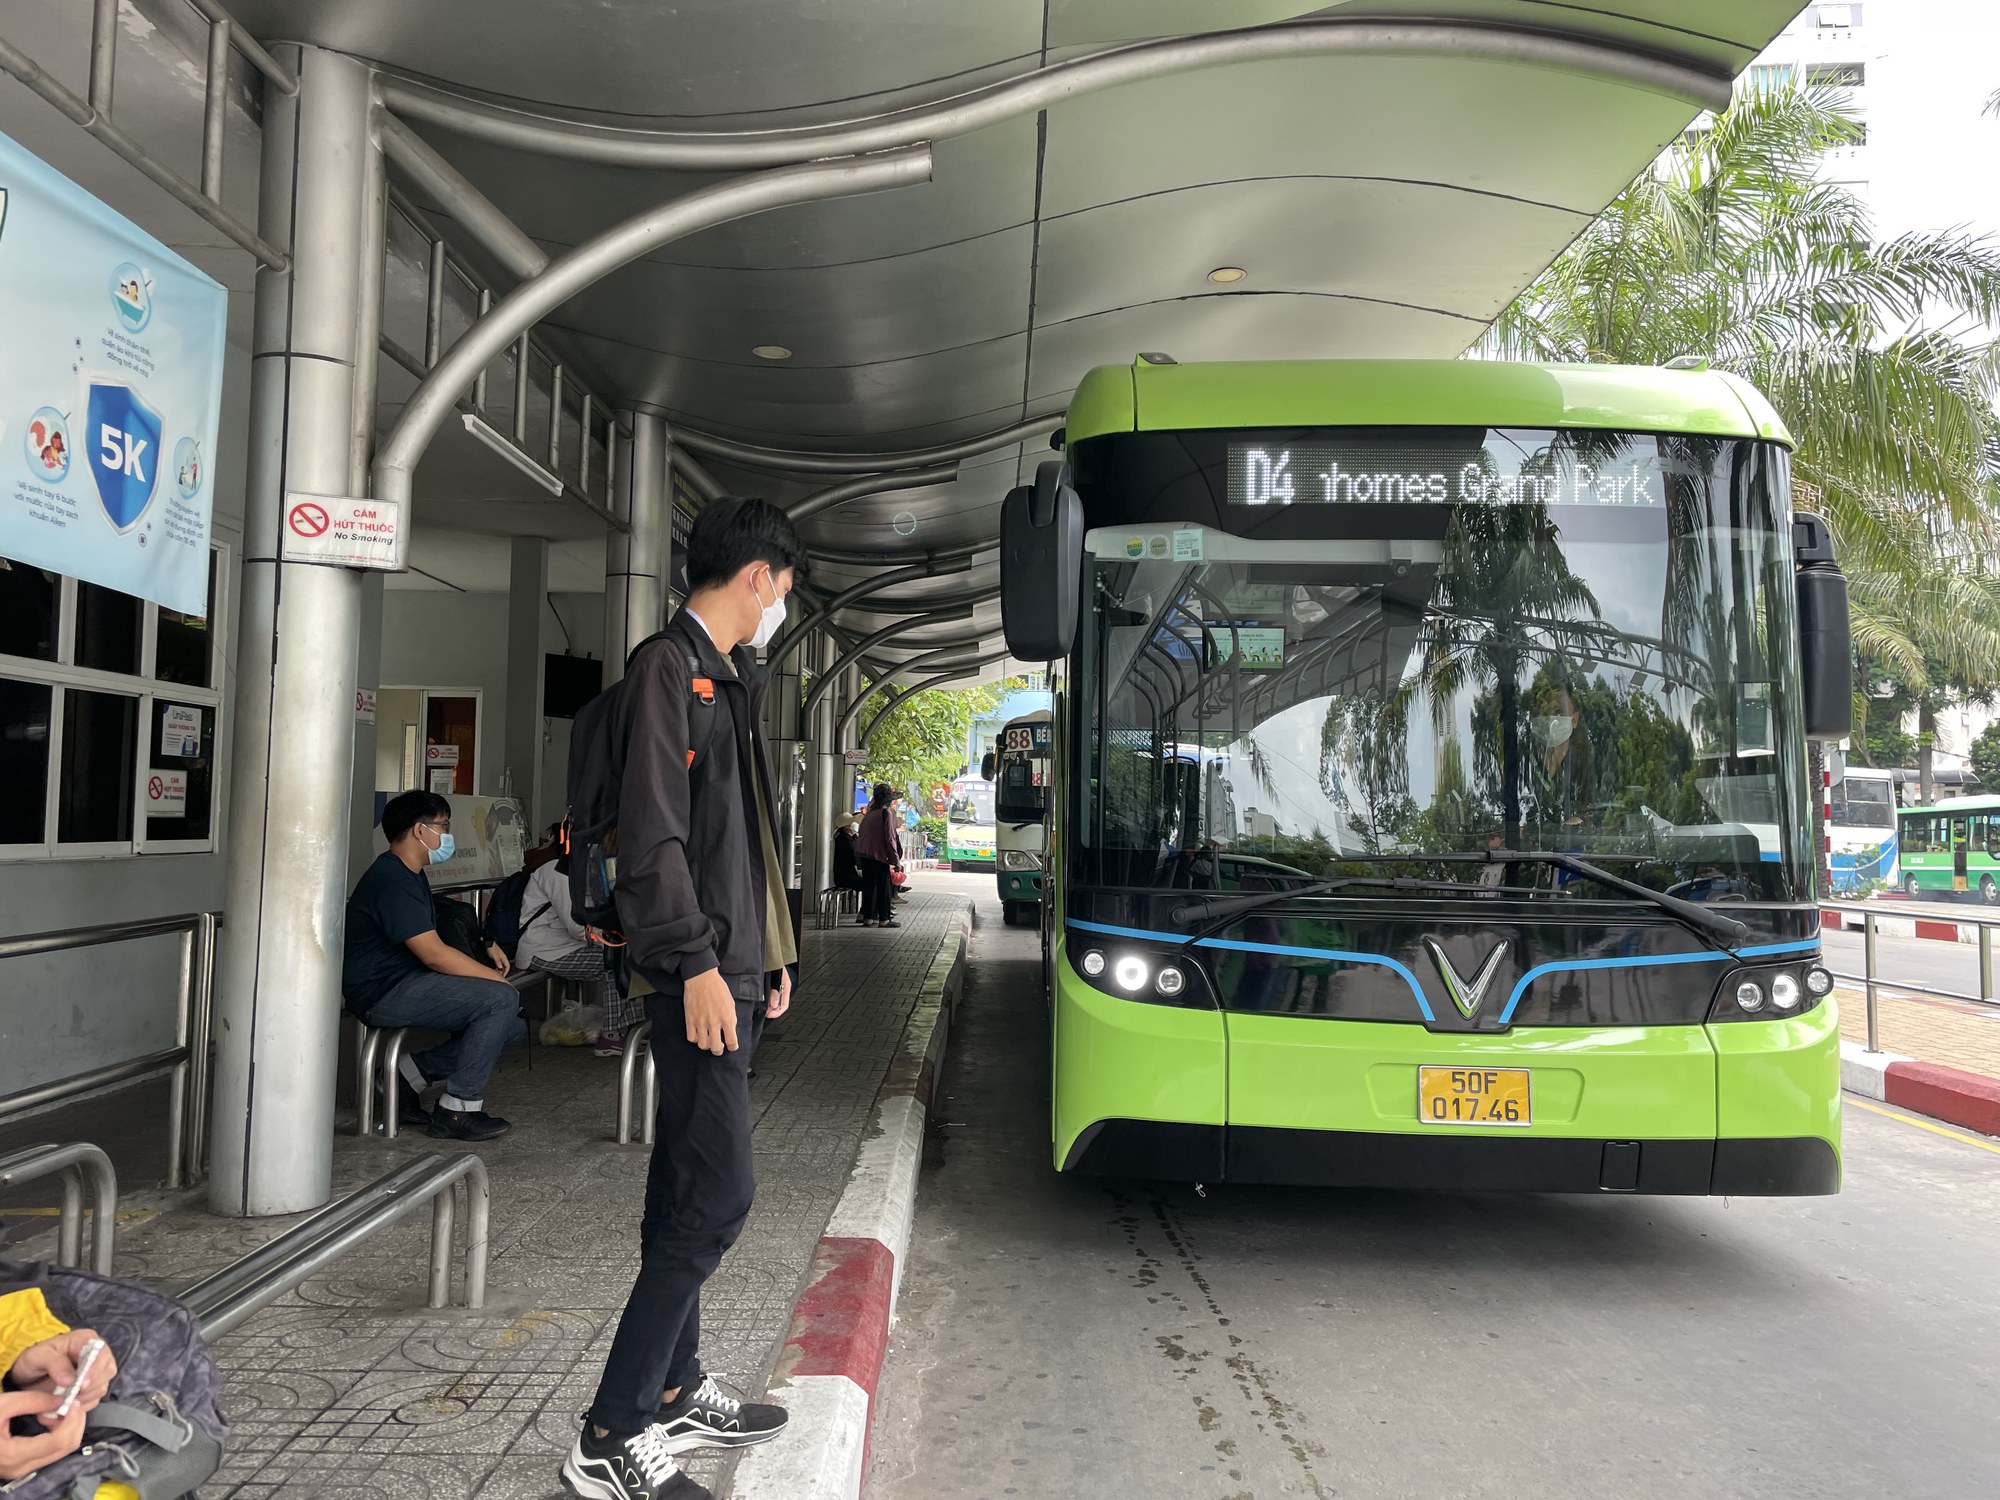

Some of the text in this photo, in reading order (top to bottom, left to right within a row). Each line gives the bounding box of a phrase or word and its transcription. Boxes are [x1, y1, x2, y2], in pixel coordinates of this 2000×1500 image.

[101, 423, 148, 483] 5K
[1247, 449, 1295, 505] D4
[1459, 463, 1561, 503] Grand
[1574, 463, 1655, 504] Park
[353, 508, 377, 519] CẤM
[334, 519, 394, 533] HÚT THUỐC
[334, 532, 393, 546] No Smoking
[1008, 729, 1031, 750] 88
[1451, 1071, 1498, 1095] 50F
[1433, 1096, 1519, 1122] 017.46
